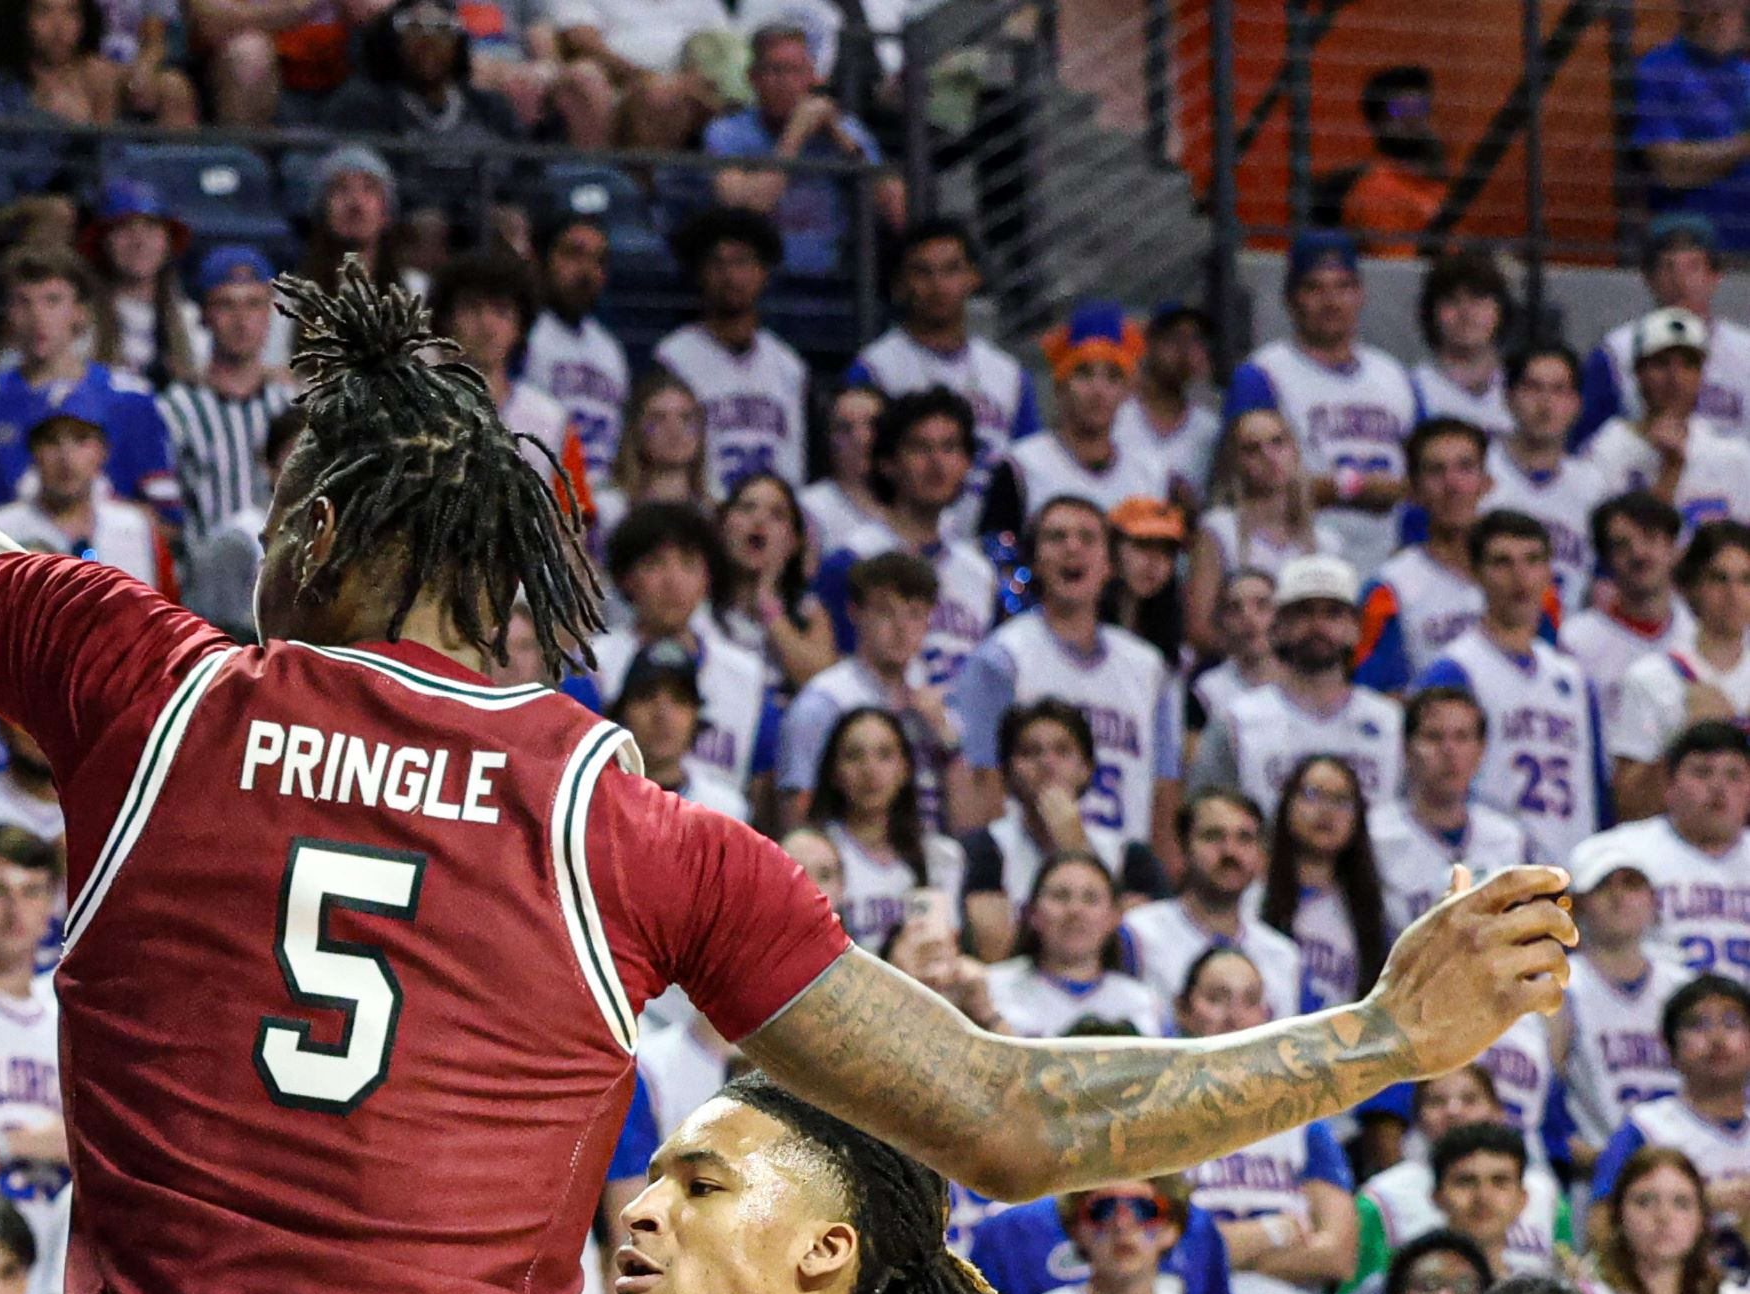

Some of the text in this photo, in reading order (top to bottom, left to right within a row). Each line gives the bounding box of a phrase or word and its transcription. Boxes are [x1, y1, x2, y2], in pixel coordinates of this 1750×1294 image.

[239, 719, 508, 824] PRINGLE
[1513, 752, 1573, 819] 25
[253, 836, 427, 1115] 5
